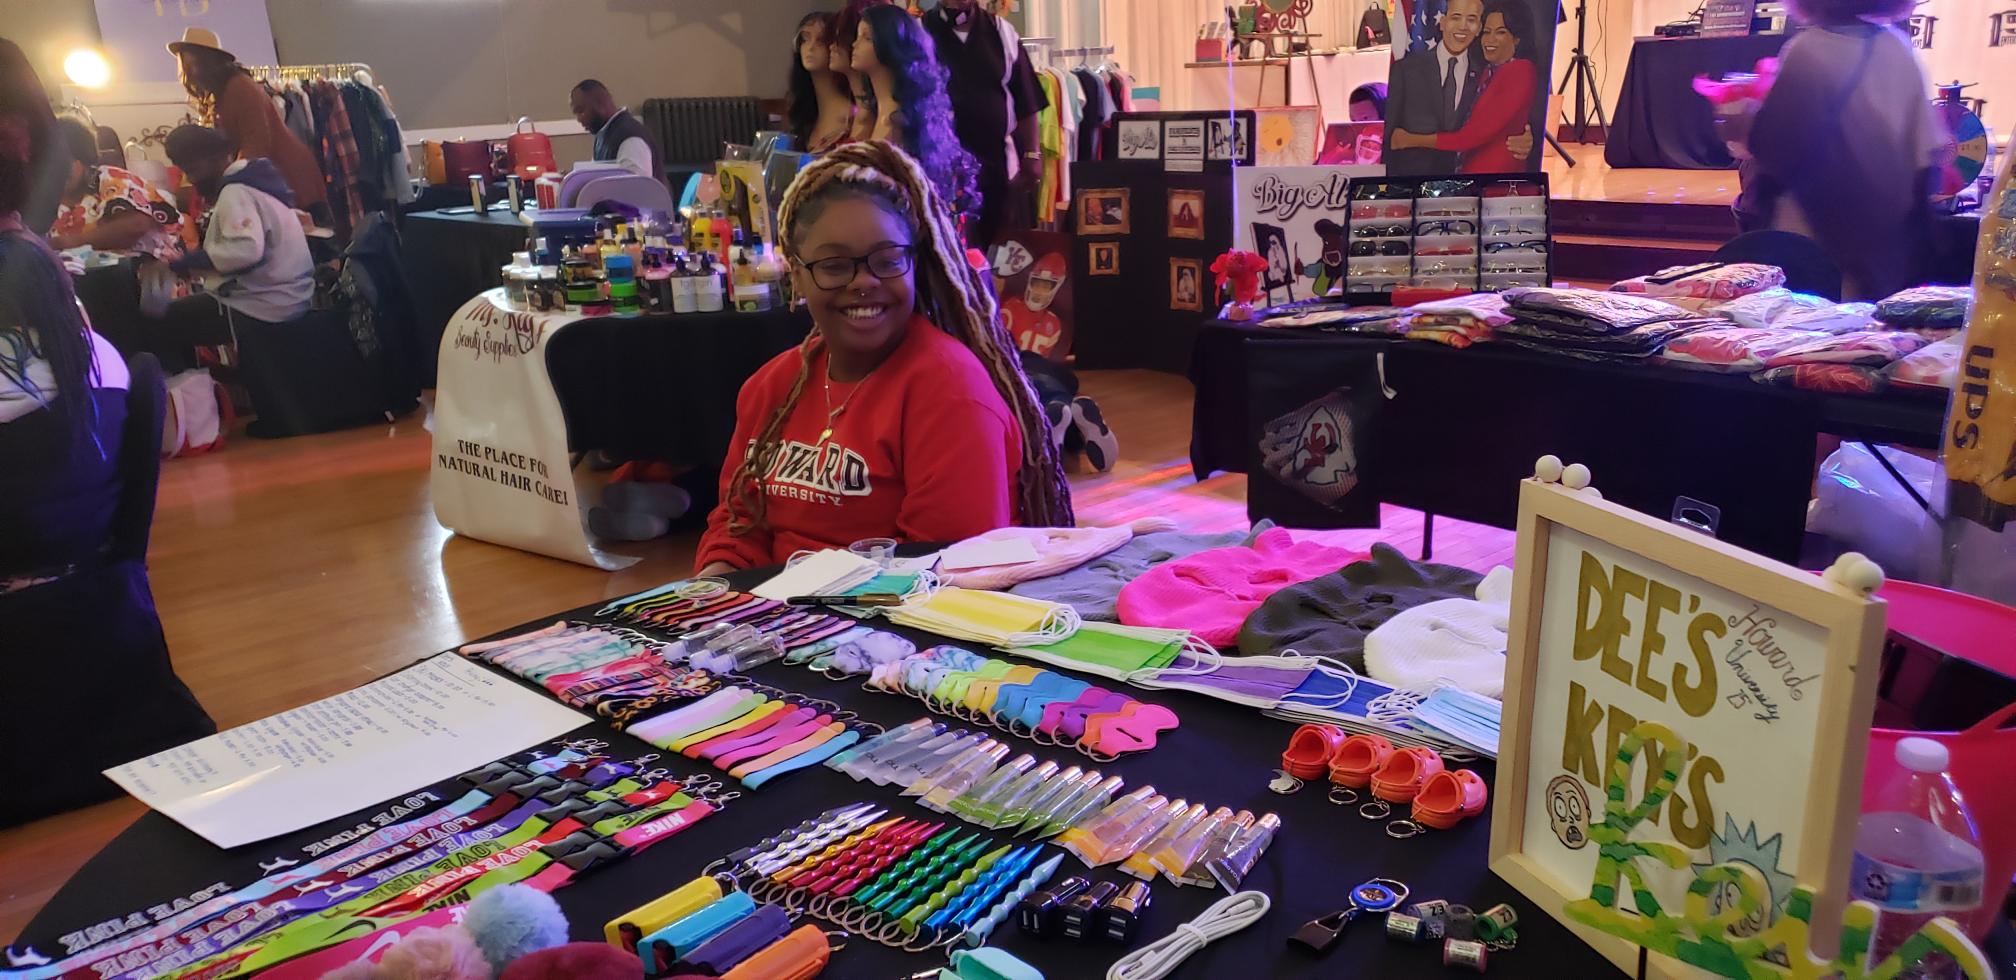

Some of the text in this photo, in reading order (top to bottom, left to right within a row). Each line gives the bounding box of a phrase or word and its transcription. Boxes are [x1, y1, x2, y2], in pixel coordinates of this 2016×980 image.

[1252, 173, 1303, 222] Big
[454, 325, 482, 361] Beauty
[438, 454, 569, 506] NATURAL HAIR CARE!
[457, 439, 549, 479] THE PLACE FOR
[1572, 550, 1727, 718] DEE'S
[1728, 603, 1821, 688] Howard
[302, 791, 441, 857] LOVE PINK
[337, 815, 480, 878] LOVE PINK
[641, 811, 686, 837] NIKE
[368, 823, 508, 884] LOVE PINK
[407, 838, 547, 898] LOVE PINK
[436, 840, 507, 871] LOVE
[59, 881, 232, 956] LOVE PINK
[184, 901, 266, 945] LOVE
[212, 900, 297, 947] LOVE
[91, 936, 186, 980] PINK
